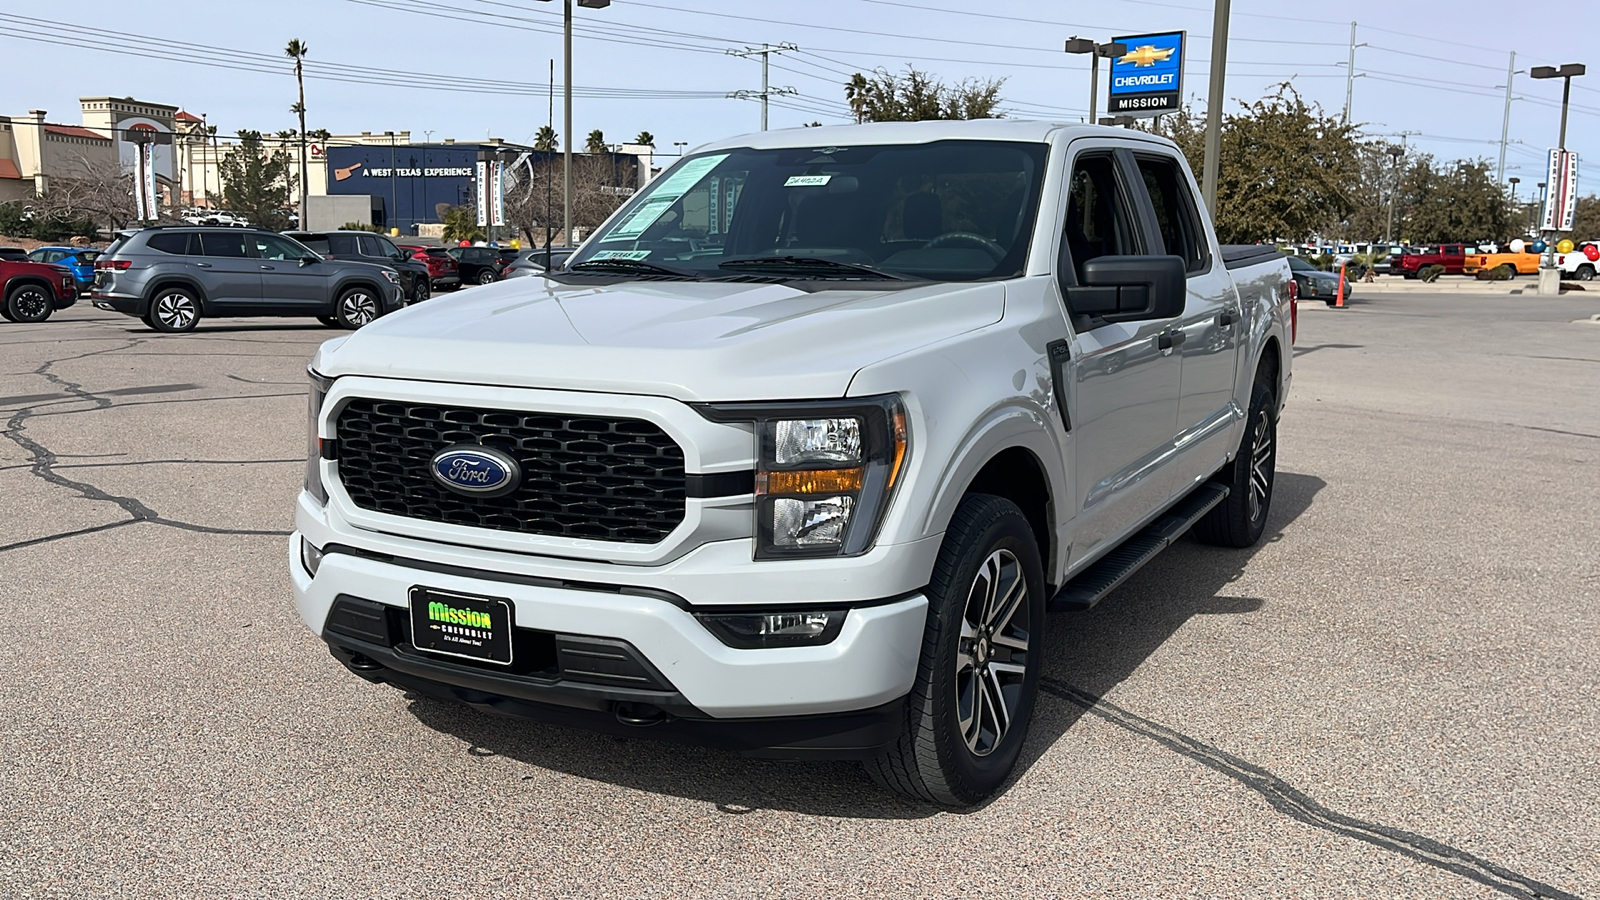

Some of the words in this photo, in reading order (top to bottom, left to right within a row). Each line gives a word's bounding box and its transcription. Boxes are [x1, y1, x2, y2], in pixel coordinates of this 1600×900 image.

[1114, 73, 1174, 87] CHEVROLET
[1118, 96, 1168, 109] MISSION
[362, 168, 369, 177] A
[371, 168, 392, 177] WEST
[395, 168, 422, 177] TEXAS
[424, 167, 473, 177] EXPERIENCE
[1546, 152, 1558, 225] CERTIFIED
[1564, 154, 1576, 226] CERTIFIED
[448, 458, 490, 484] Ford
[428, 601, 492, 630] Mission
[441, 624, 493, 640] CHEVROLET
[472, 639, 482, 647] You!
